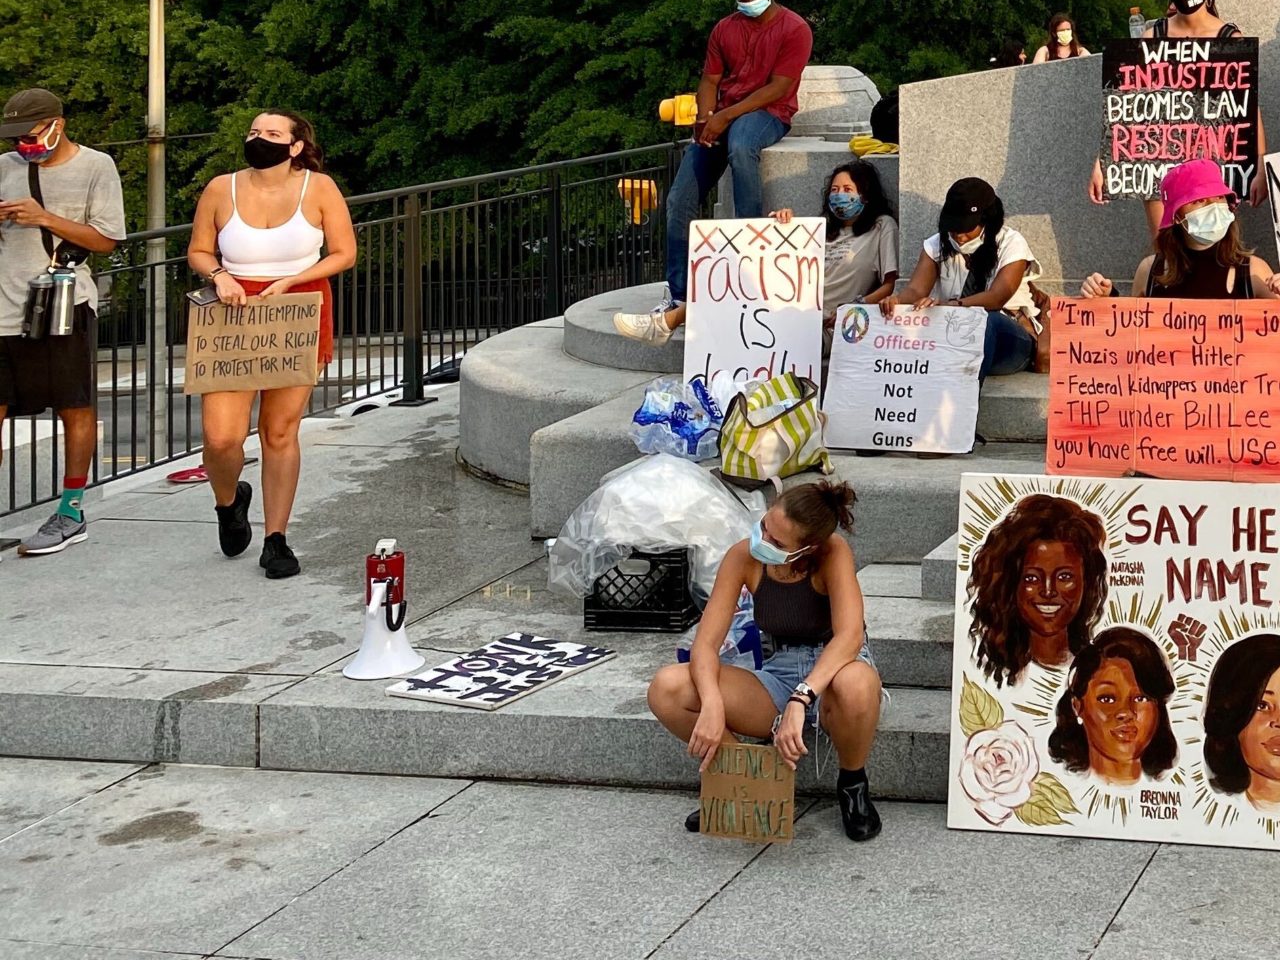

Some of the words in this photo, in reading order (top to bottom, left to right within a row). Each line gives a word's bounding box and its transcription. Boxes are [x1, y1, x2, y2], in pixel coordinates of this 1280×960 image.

[1142, 41, 1211, 64] WHEN
[1119, 61, 1251, 91] INJUSTICE
[1107, 91, 1194, 123] BECOMES
[1203, 90, 1249, 120] LAW
[1112, 123, 1251, 162] RESISTANCE
[690, 244, 822, 311] racism
[221, 304, 244, 327] THE
[739, 304, 775, 349] is
[1106, 303, 1154, 337] just
[1163, 302, 1206, 344] doing
[1219, 313, 1243, 343] my
[212, 334, 250, 352] STEAL
[250, 334, 278, 351] OUR
[285, 330, 320, 349] RIGHT
[873, 334, 936, 351] Officers
[260, 355, 278, 374] FOR
[282, 355, 303, 371] ME
[874, 359, 929, 375] Should
[1127, 342, 1181, 366] under
[1192, 344, 1245, 367] Hitler
[883, 384, 914, 398] Not
[1128, 374, 1197, 400] kidnappers
[1204, 378, 1248, 395] under
[874, 407, 917, 423] Need
[1119, 402, 1175, 428] under
[1184, 400, 1221, 430] Bill
[1228, 401, 1272, 428] Lee
[872, 431, 914, 448] Guns
[1054, 439, 1083, 468] you
[1088, 436, 1130, 461] have
[1137, 436, 1177, 463] free
[1125, 504, 1208, 546] SAY
[1111, 561, 1145, 575] NATASHA
[709, 748, 786, 782] SILENCE
[1140, 789, 1182, 807] BREONNA
[701, 797, 791, 839] VIOLENCE
[1140, 805, 1179, 821] TAYLOR
